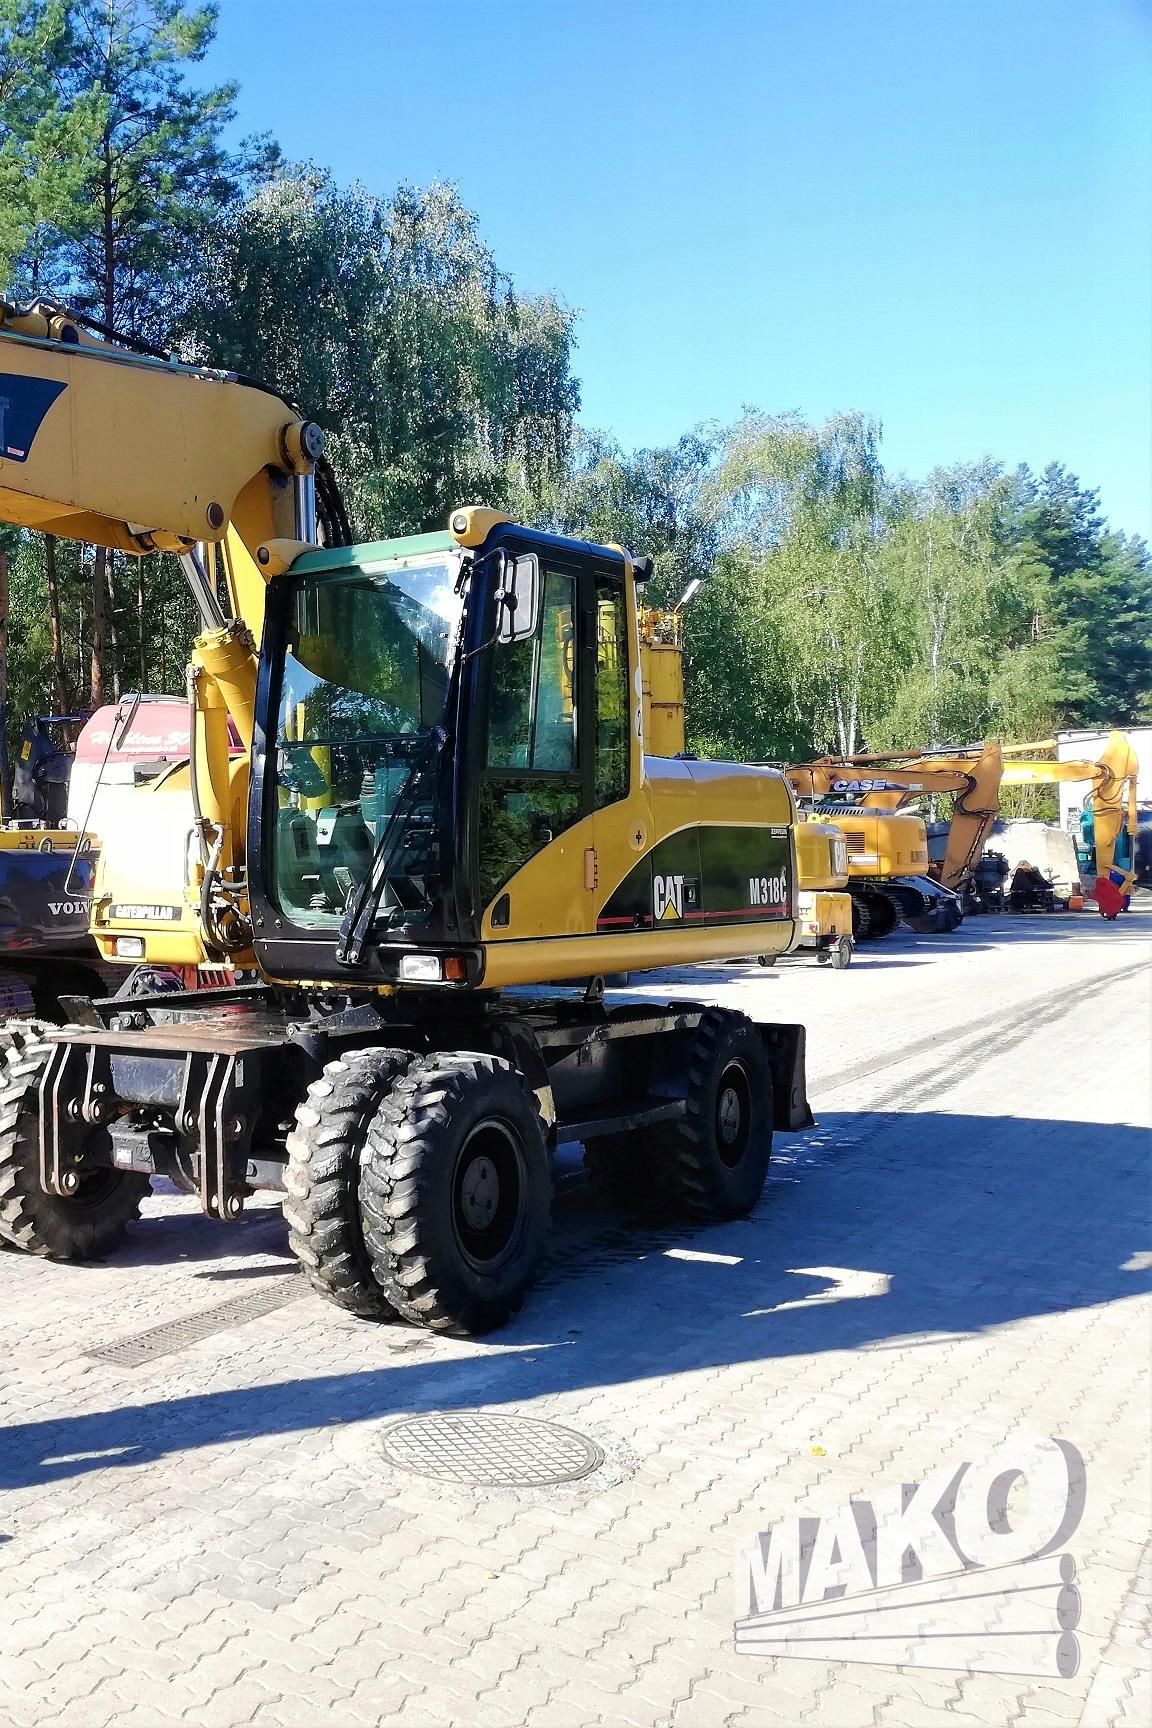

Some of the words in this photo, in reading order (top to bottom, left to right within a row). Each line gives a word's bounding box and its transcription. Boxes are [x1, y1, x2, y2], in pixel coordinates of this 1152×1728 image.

[833, 779, 887, 792] CASE
[654, 874, 684, 920] CAT
[749, 876, 788, 905] M318C
[48, 901, 90, 915] VOLV
[115, 905, 174, 920] CATERPILLAR
